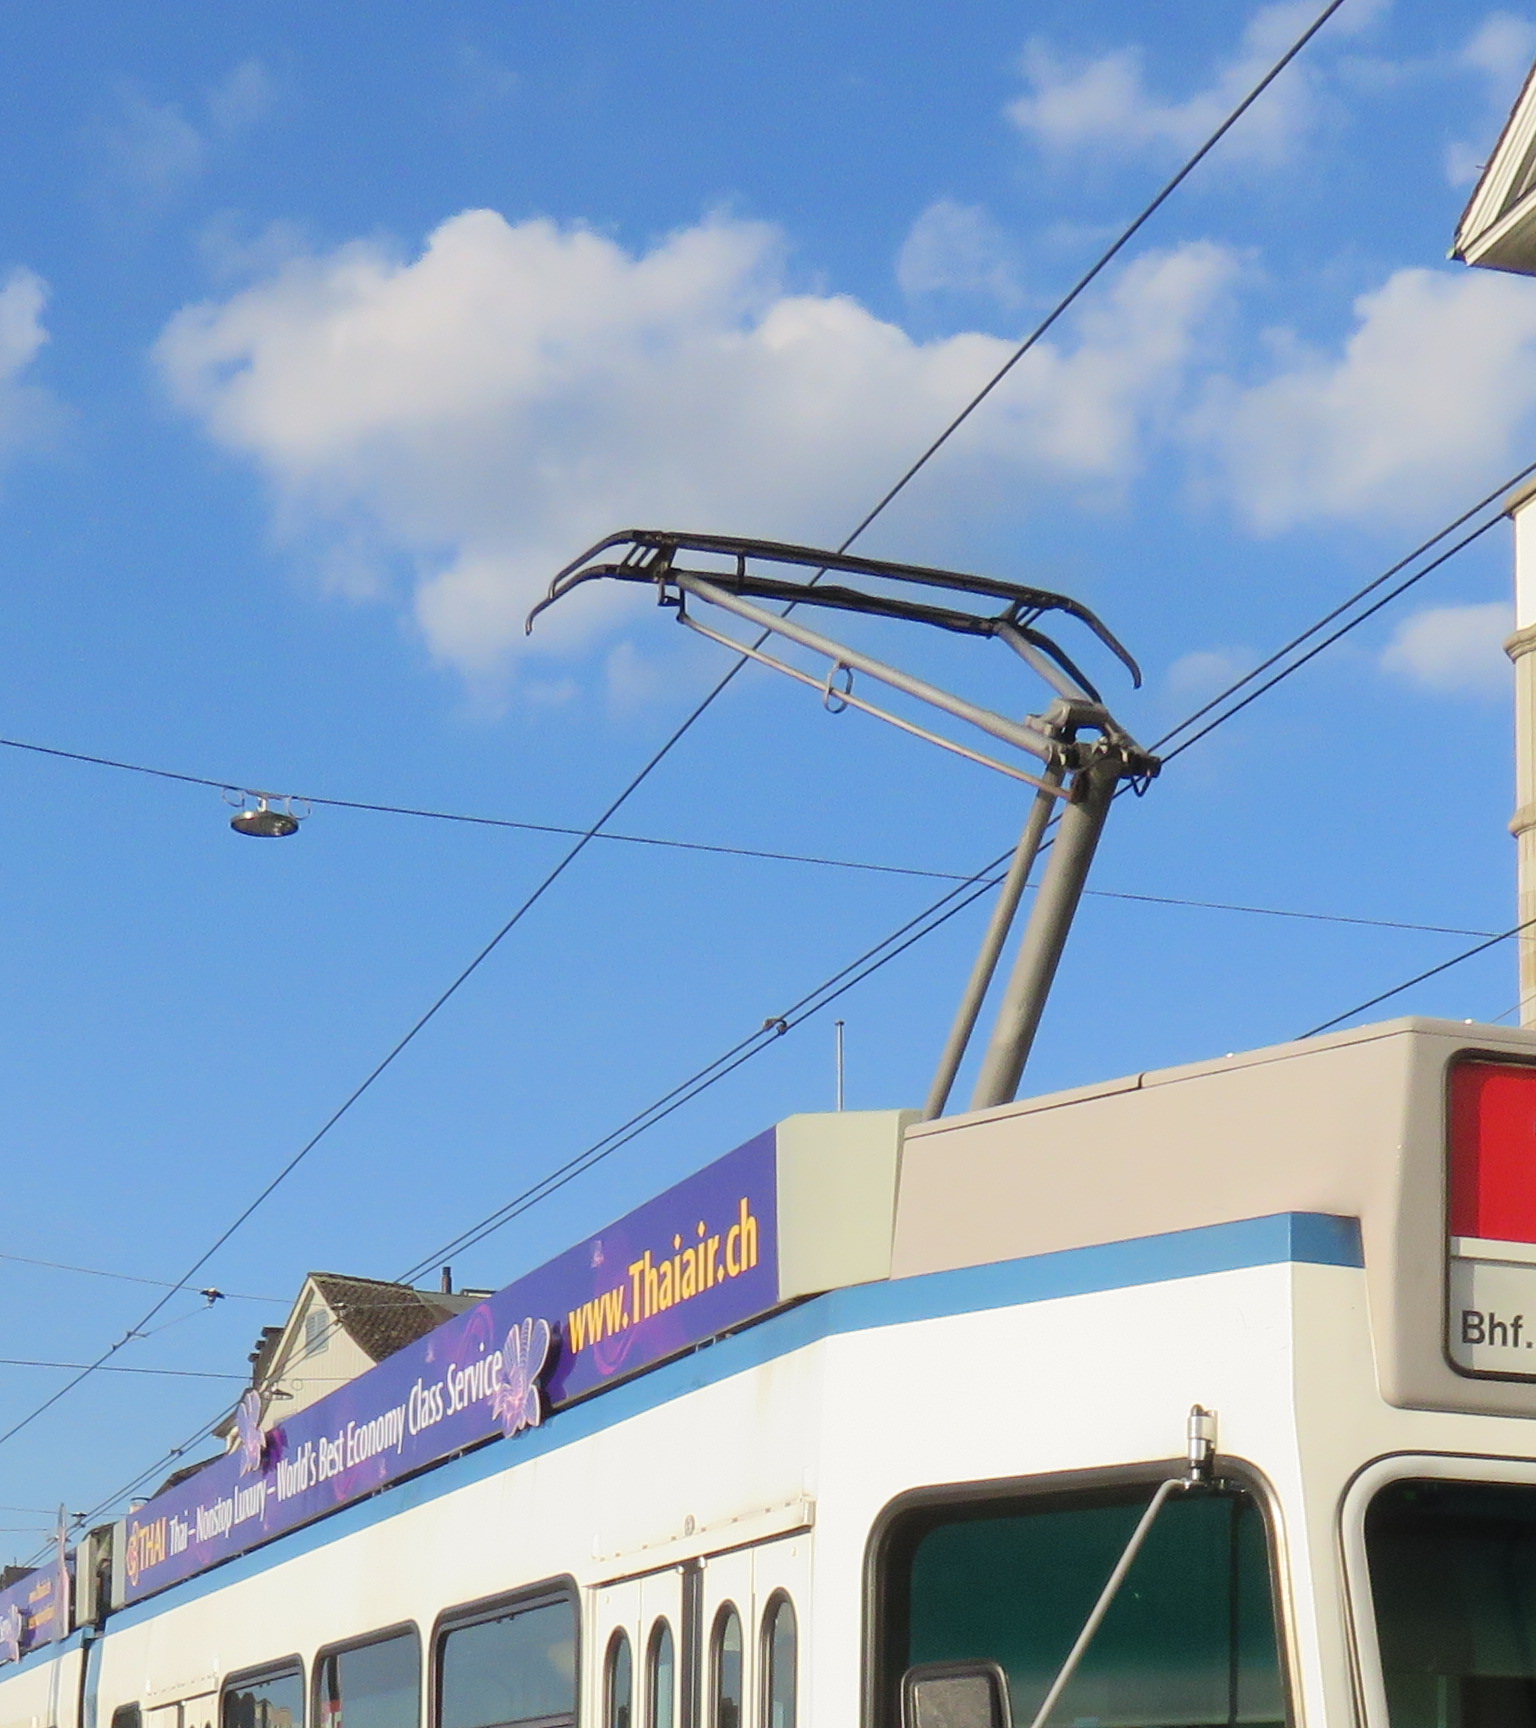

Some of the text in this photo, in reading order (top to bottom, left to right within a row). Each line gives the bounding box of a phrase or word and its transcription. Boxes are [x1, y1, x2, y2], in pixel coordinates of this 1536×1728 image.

[568, 1196, 757, 1354] www.Thaiair.ch
[1461, 1310, 1534, 1349] Bhf.
[139, 1516, 167, 1572] THAI
[169, 1509, 188, 1556] Thai
[196, 1497, 233, 1544] Nonstop
[234, 1480, 266, 1525] Luxury
[277, 1441, 316, 1502] World's
[319, 1430, 345, 1482] Best
[347, 1404, 406, 1468] Economy
[408, 1377, 444, 1436] Class
[446, 1342, 503, 1416] Service
